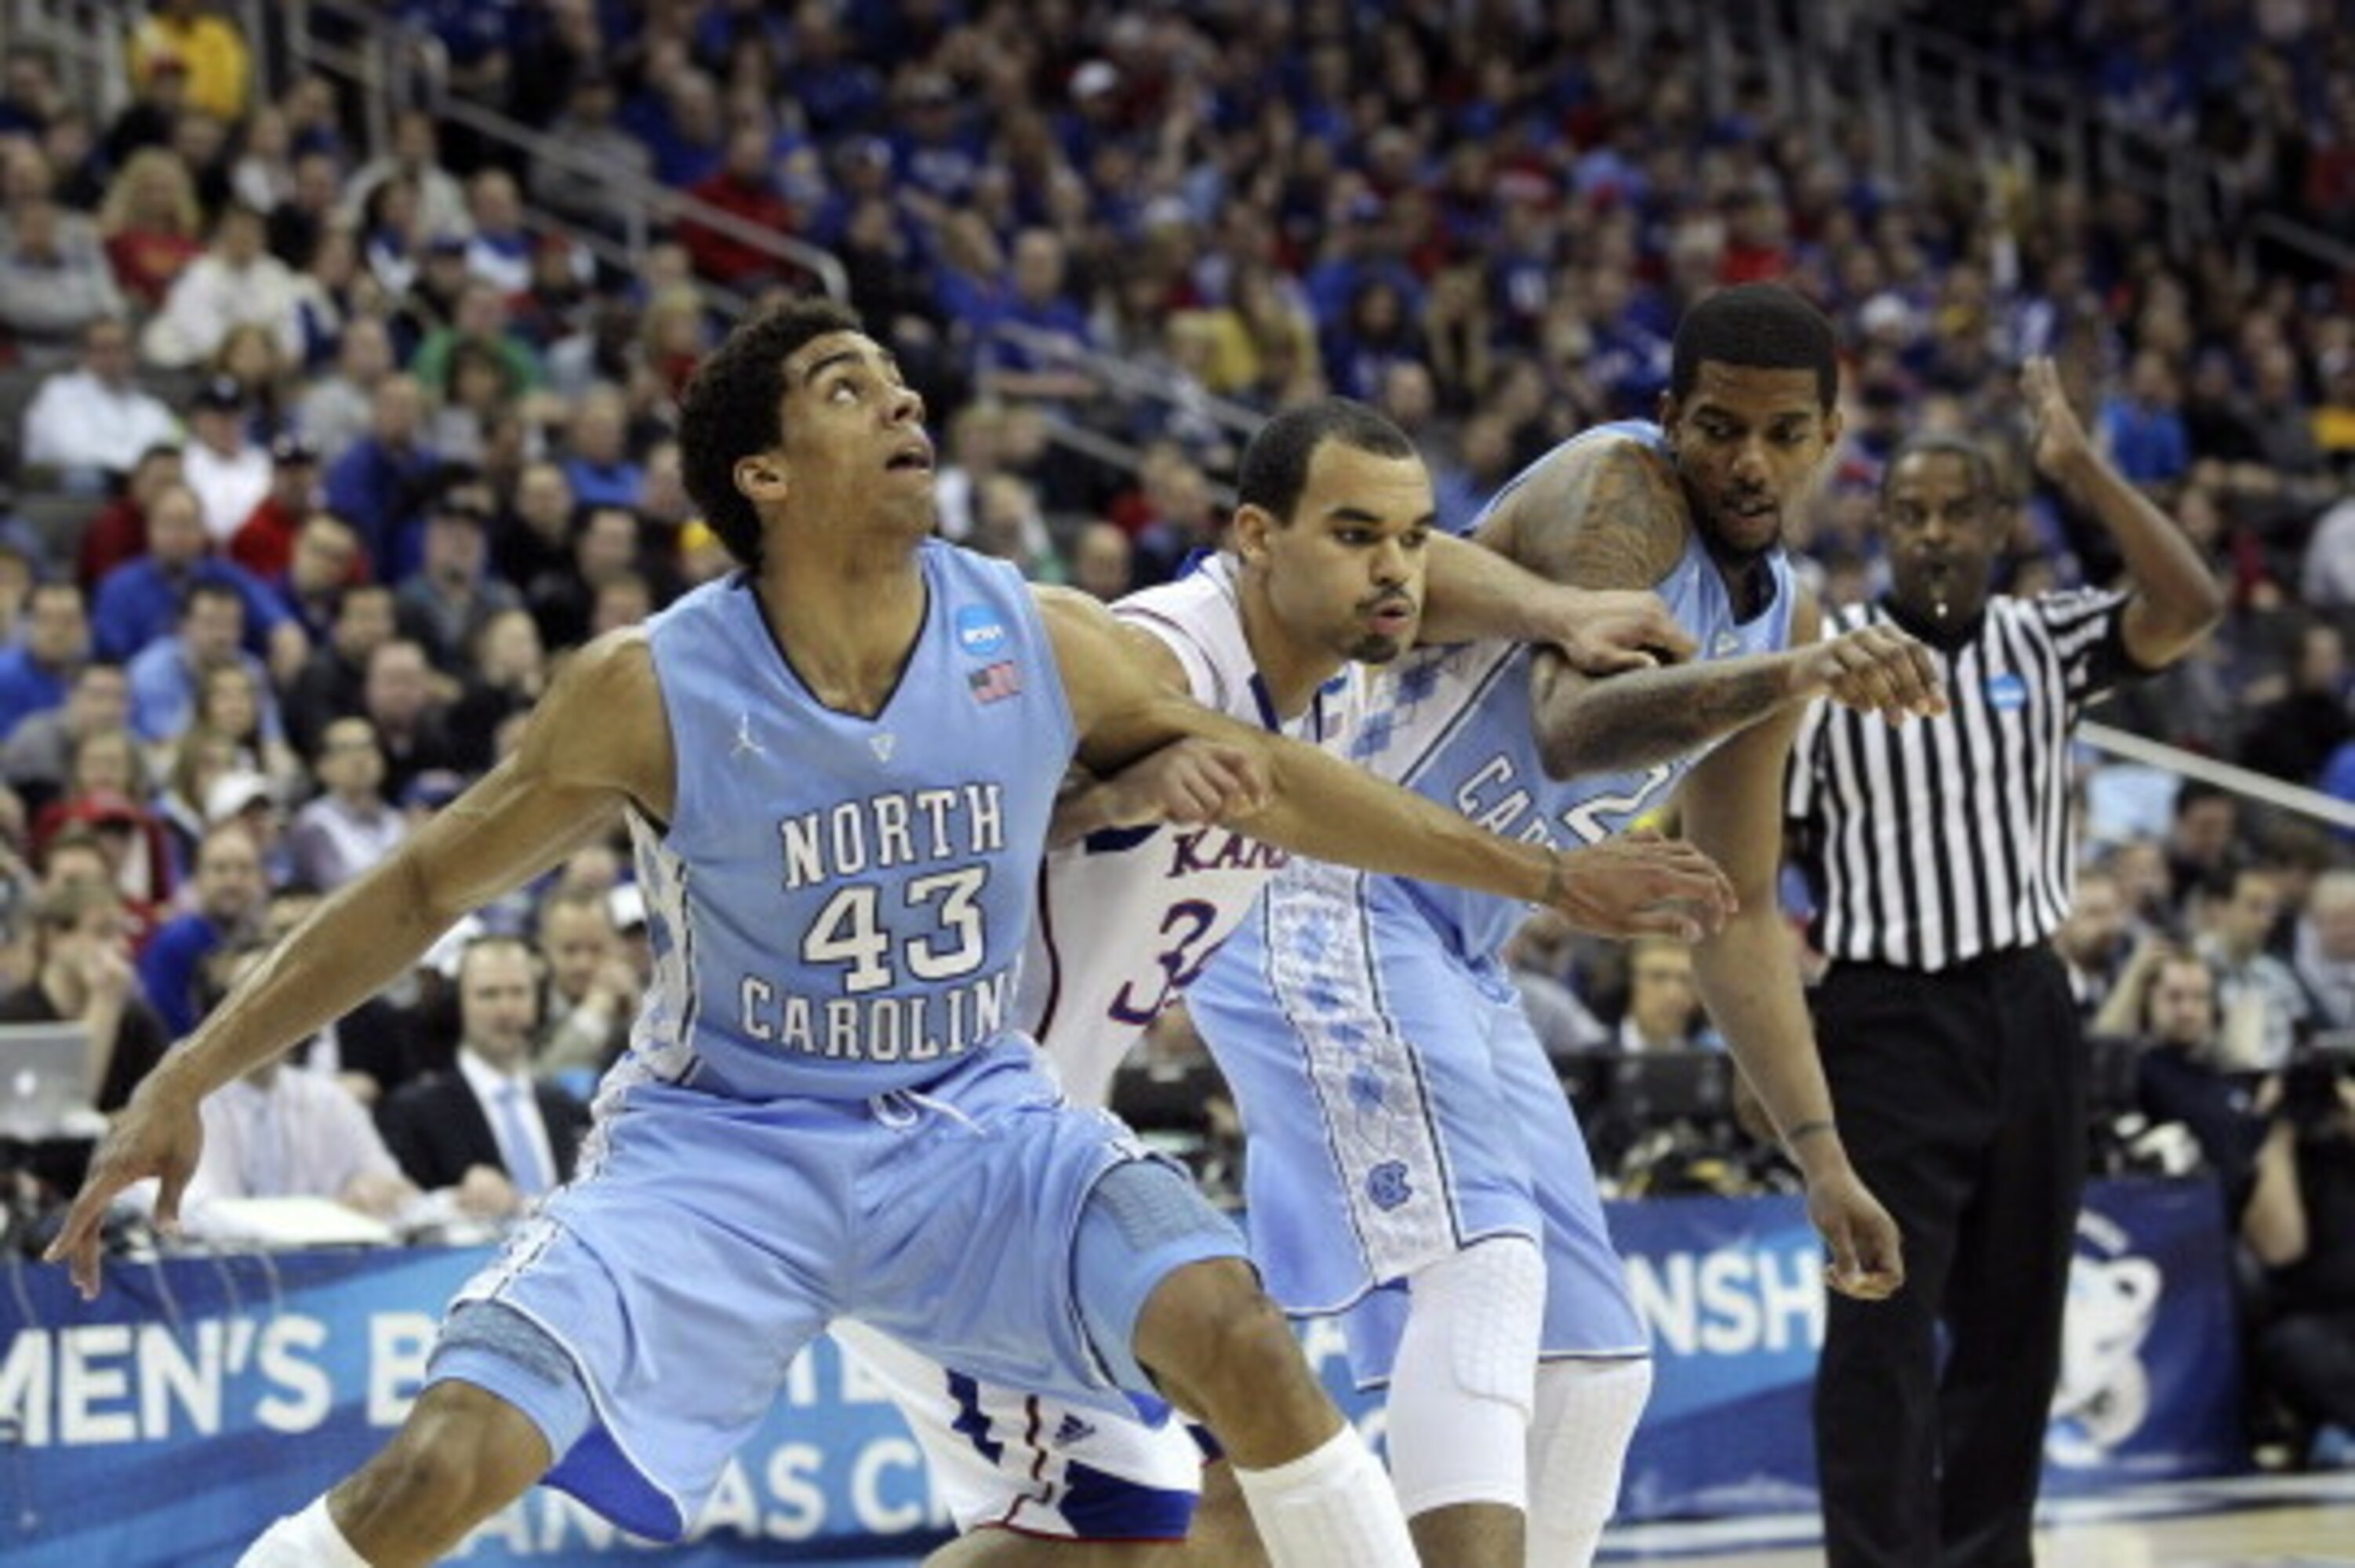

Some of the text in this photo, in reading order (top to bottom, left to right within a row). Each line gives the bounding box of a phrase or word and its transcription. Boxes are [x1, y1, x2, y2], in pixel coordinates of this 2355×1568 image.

[779, 782, 1005, 891] NORTH
[800, 862, 990, 994] 43
[740, 950, 1023, 1062] CAROLIN
